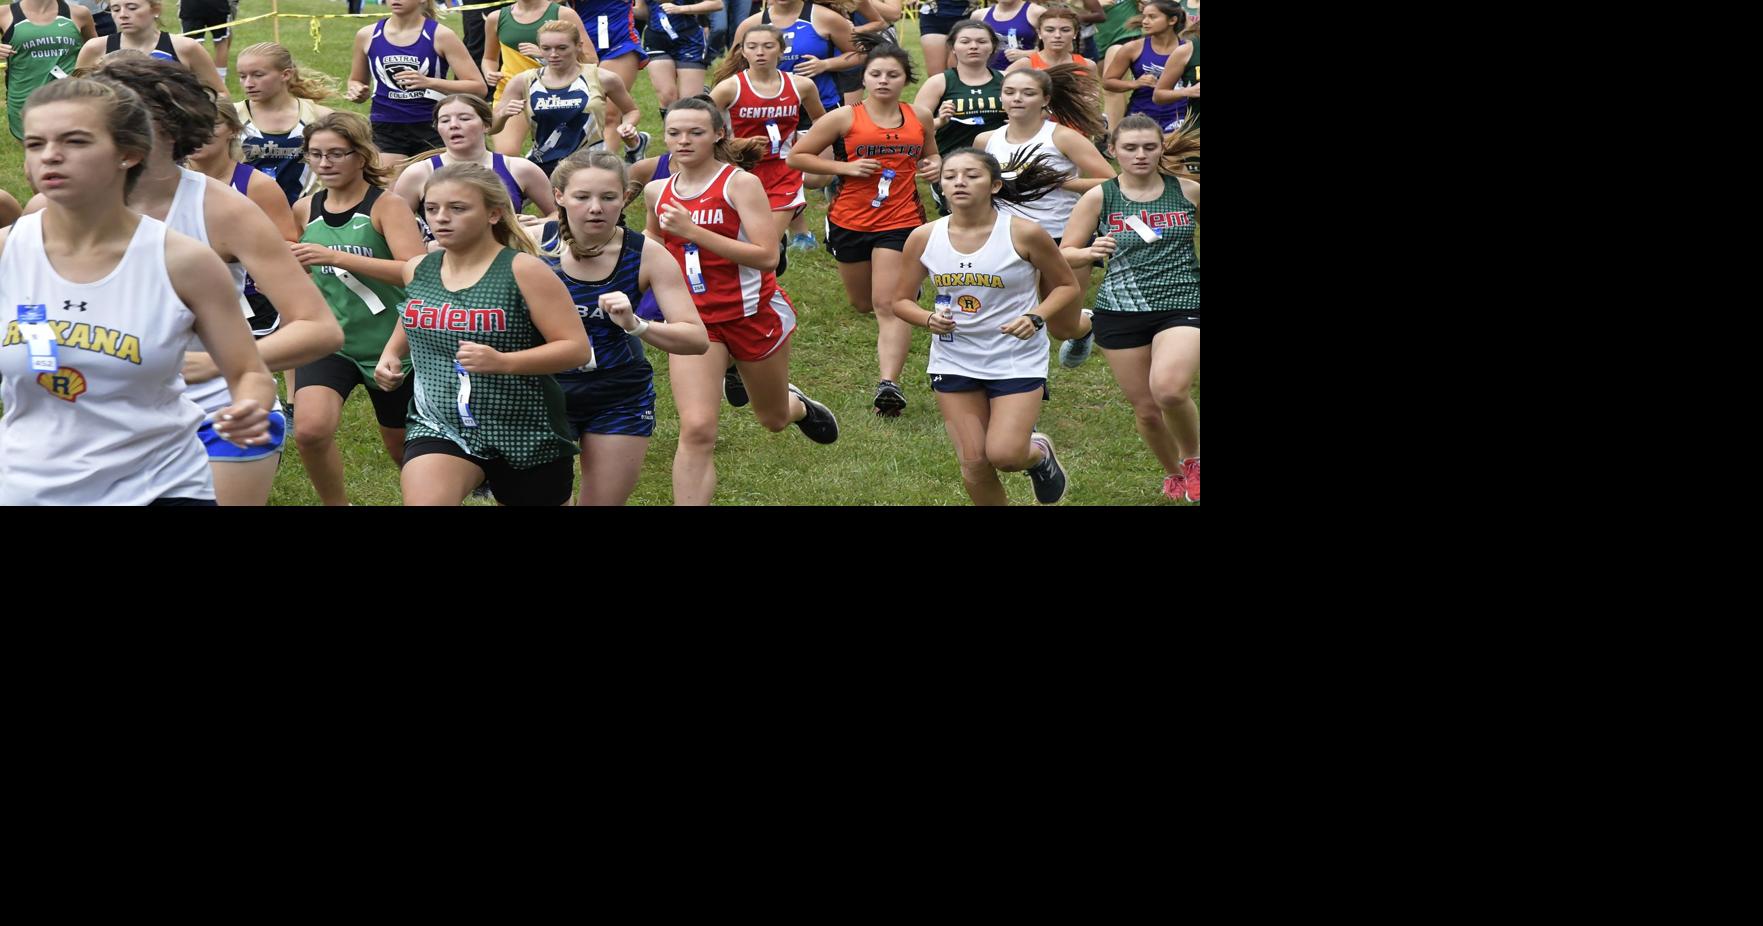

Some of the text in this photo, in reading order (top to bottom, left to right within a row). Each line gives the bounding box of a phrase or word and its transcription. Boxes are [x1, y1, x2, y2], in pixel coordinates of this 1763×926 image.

[23, 36, 75, 49] HAMILTON
[31, 48, 69, 58] COUNTY
[739, 105, 797, 118] CENTRALIA
[934, 272, 1005, 288] ROXANA
[965, 299, 974, 309] R
[404, 299, 507, 332] Salem
[2, 319, 143, 365] RXANA
[52, 376, 70, 395] R
